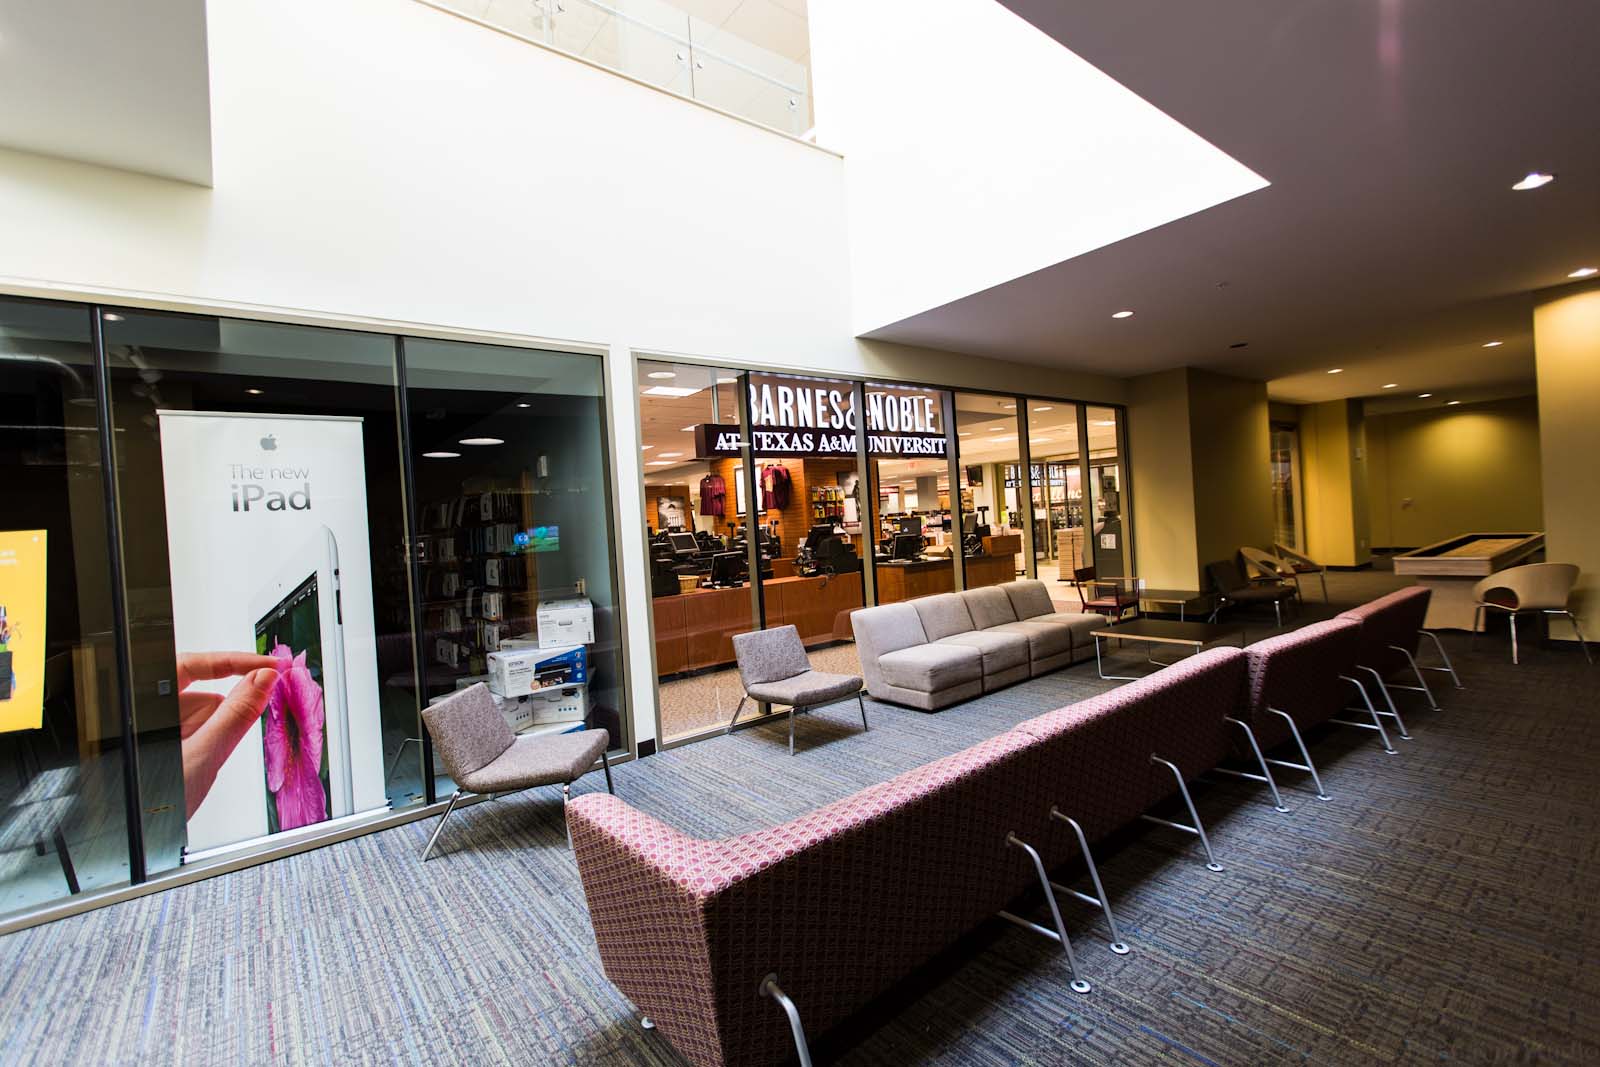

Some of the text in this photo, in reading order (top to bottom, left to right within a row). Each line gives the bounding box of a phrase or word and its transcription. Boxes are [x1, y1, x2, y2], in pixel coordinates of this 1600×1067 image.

[869, 394, 936, 432] NOBLE
[714, 431, 947, 453] AT TEXAS A&M NIVERSIT
[228, 463, 310, 480] The new
[231, 482, 311, 512] iPad
